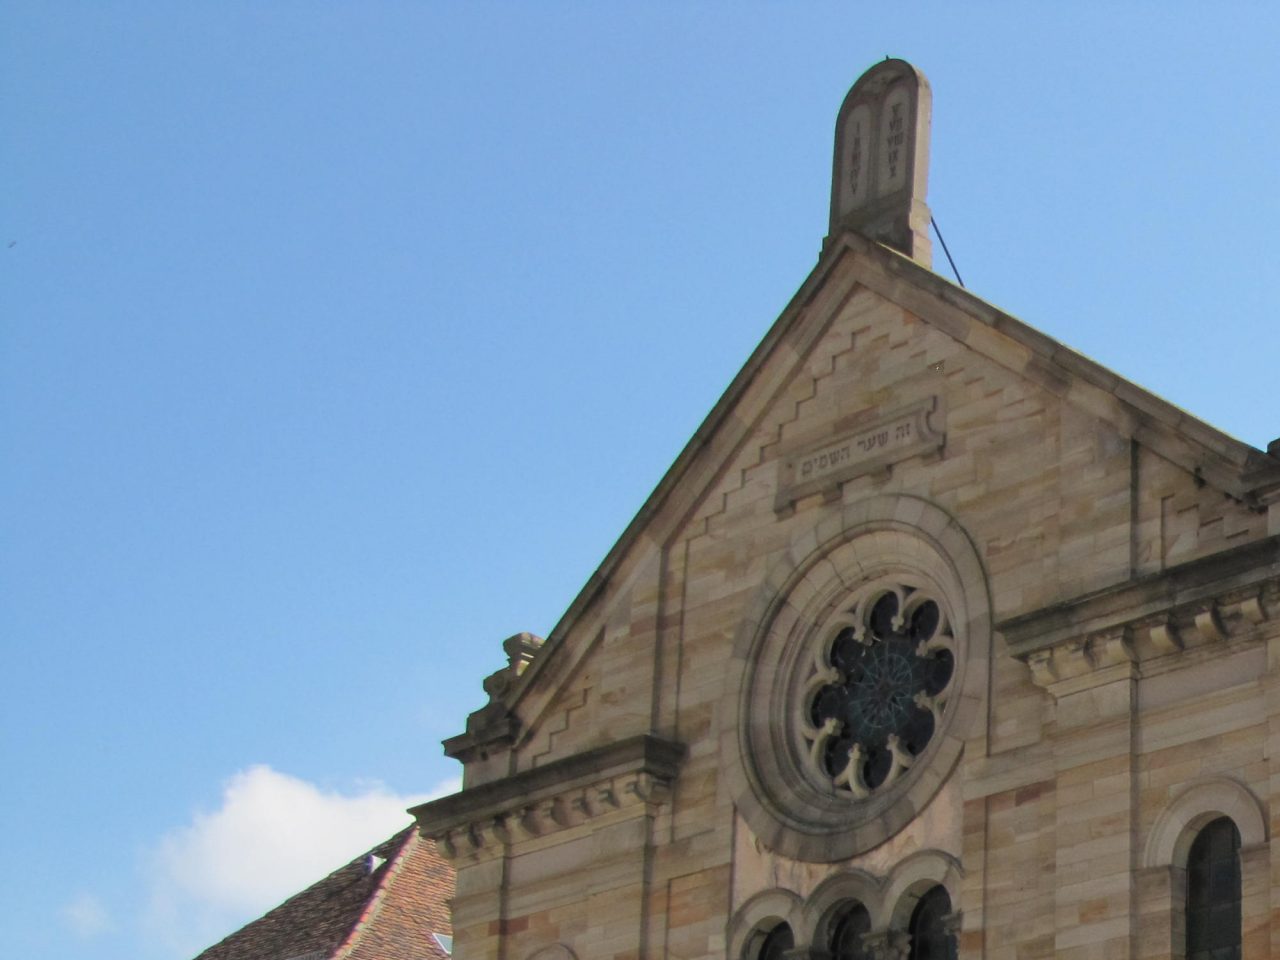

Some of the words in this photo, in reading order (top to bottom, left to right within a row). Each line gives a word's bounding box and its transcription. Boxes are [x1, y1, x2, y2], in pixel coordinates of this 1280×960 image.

[857, 431, 888, 451] שער
[896, 423, 910, 440] זה
[802, 446, 849, 476] השמים
